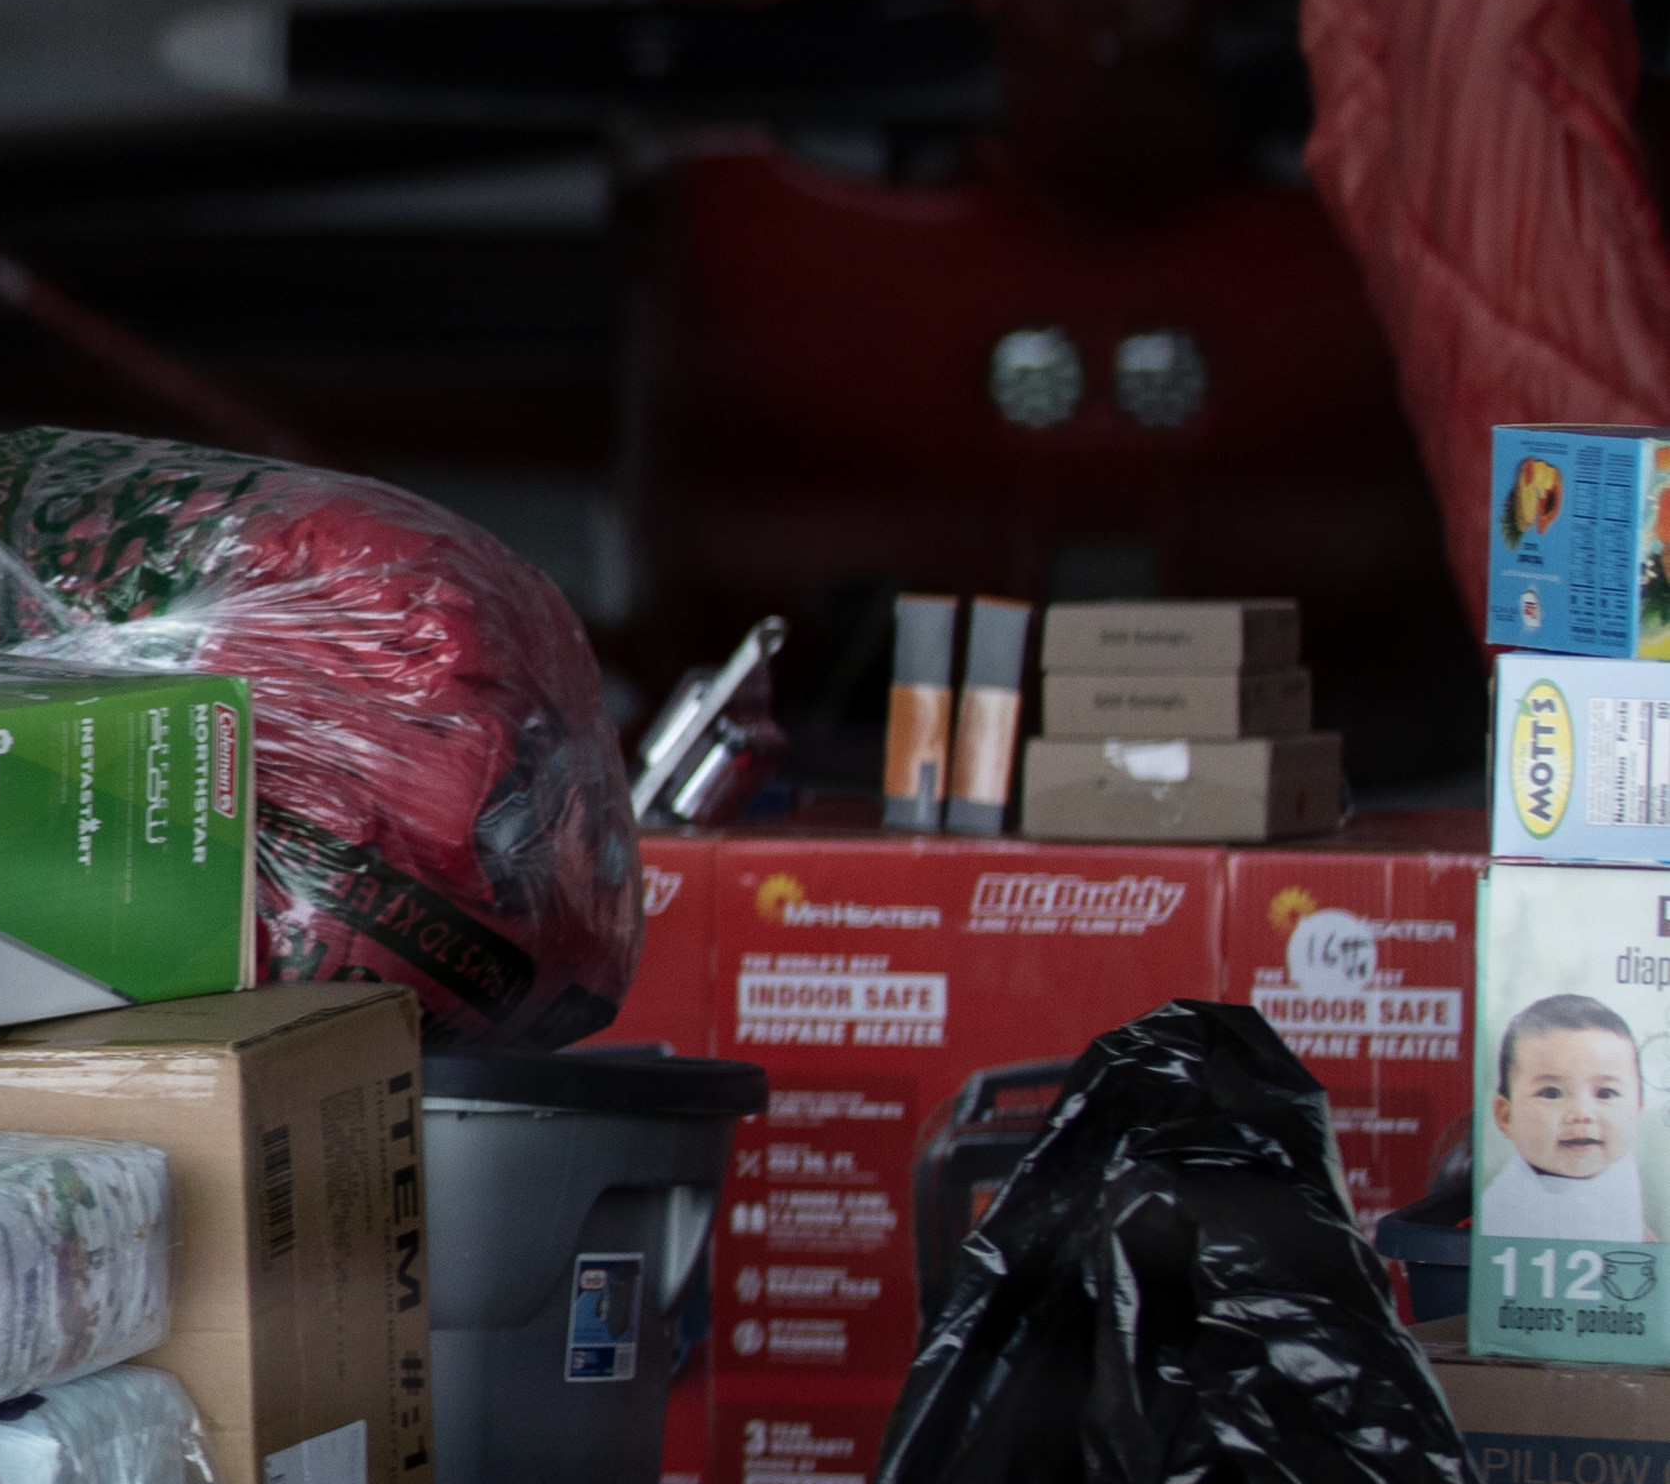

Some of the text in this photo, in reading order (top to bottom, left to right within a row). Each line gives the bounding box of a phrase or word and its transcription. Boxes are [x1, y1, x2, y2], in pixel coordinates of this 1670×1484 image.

[218, 707, 236, 793] Coleman
[192, 702, 210, 864] NORTHSTAR
[1050, 873, 1187, 926] Buddy
[747, 984, 934, 1012] INDOOR SAFE
[1259, 998, 1450, 1026] INDOOR SAFE
[736, 1023, 946, 1047] PROPANE HEATER
[1368, 1035, 1460, 1062] HEATER
[387, 1071, 422, 1314] ITEM
[1490, 1247, 1604, 1301] 112
